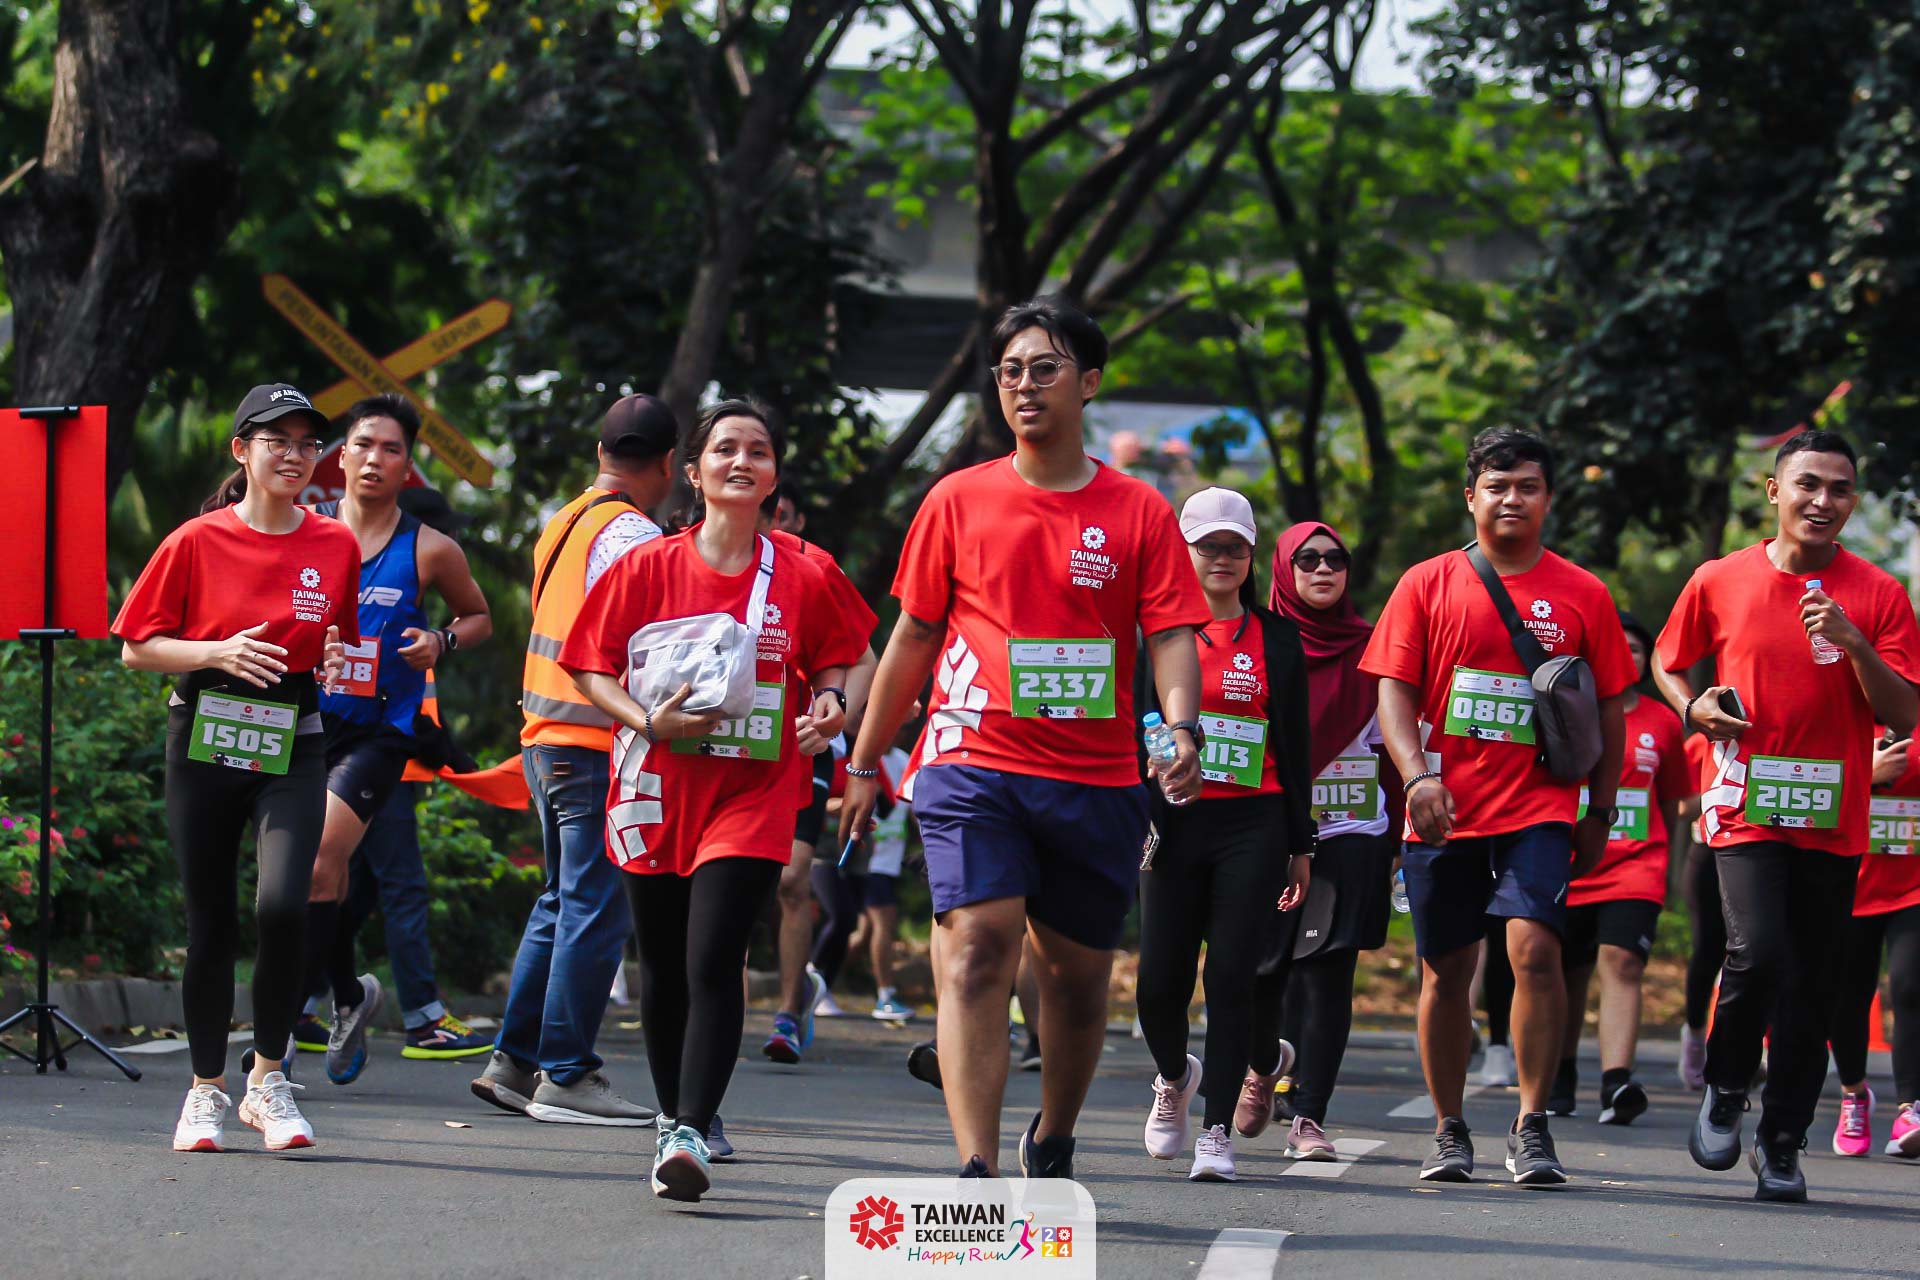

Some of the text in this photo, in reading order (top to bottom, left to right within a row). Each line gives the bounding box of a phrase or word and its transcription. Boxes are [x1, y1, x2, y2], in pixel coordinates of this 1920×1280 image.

[270, 390, 282, 401] LOS
[1071, 549, 1109, 565] TAIWAN
[1070, 560, 1108, 572] EXCELLENCE
[1070, 567, 1091, 577] Happy
[1073, 576, 1102, 589] 2024
[292, 589, 326, 601] TAIWAN
[293, 598, 326, 608] EXCELLENCE
[1523, 620, 1557, 631] TAIWAN
[759, 627, 787, 639] AIWAN
[758, 637, 786, 646] XCELLENCE
[1222, 670, 1257, 682] TAIWAN
[1018, 672, 1107, 698] 2337
[1222, 679, 1256, 688] EXCELLENCE
[1453, 697, 1534, 726] 0867
[202, 722, 283, 756] 1505
[719, 747, 731, 755] 5K
[1200, 741, 1249, 768] 113
[232, 758, 244, 767] 5K
[1312, 783, 1367, 805] 0115
[1756, 785, 1833, 811] 2159
[1787, 817, 1799, 825] 5K
